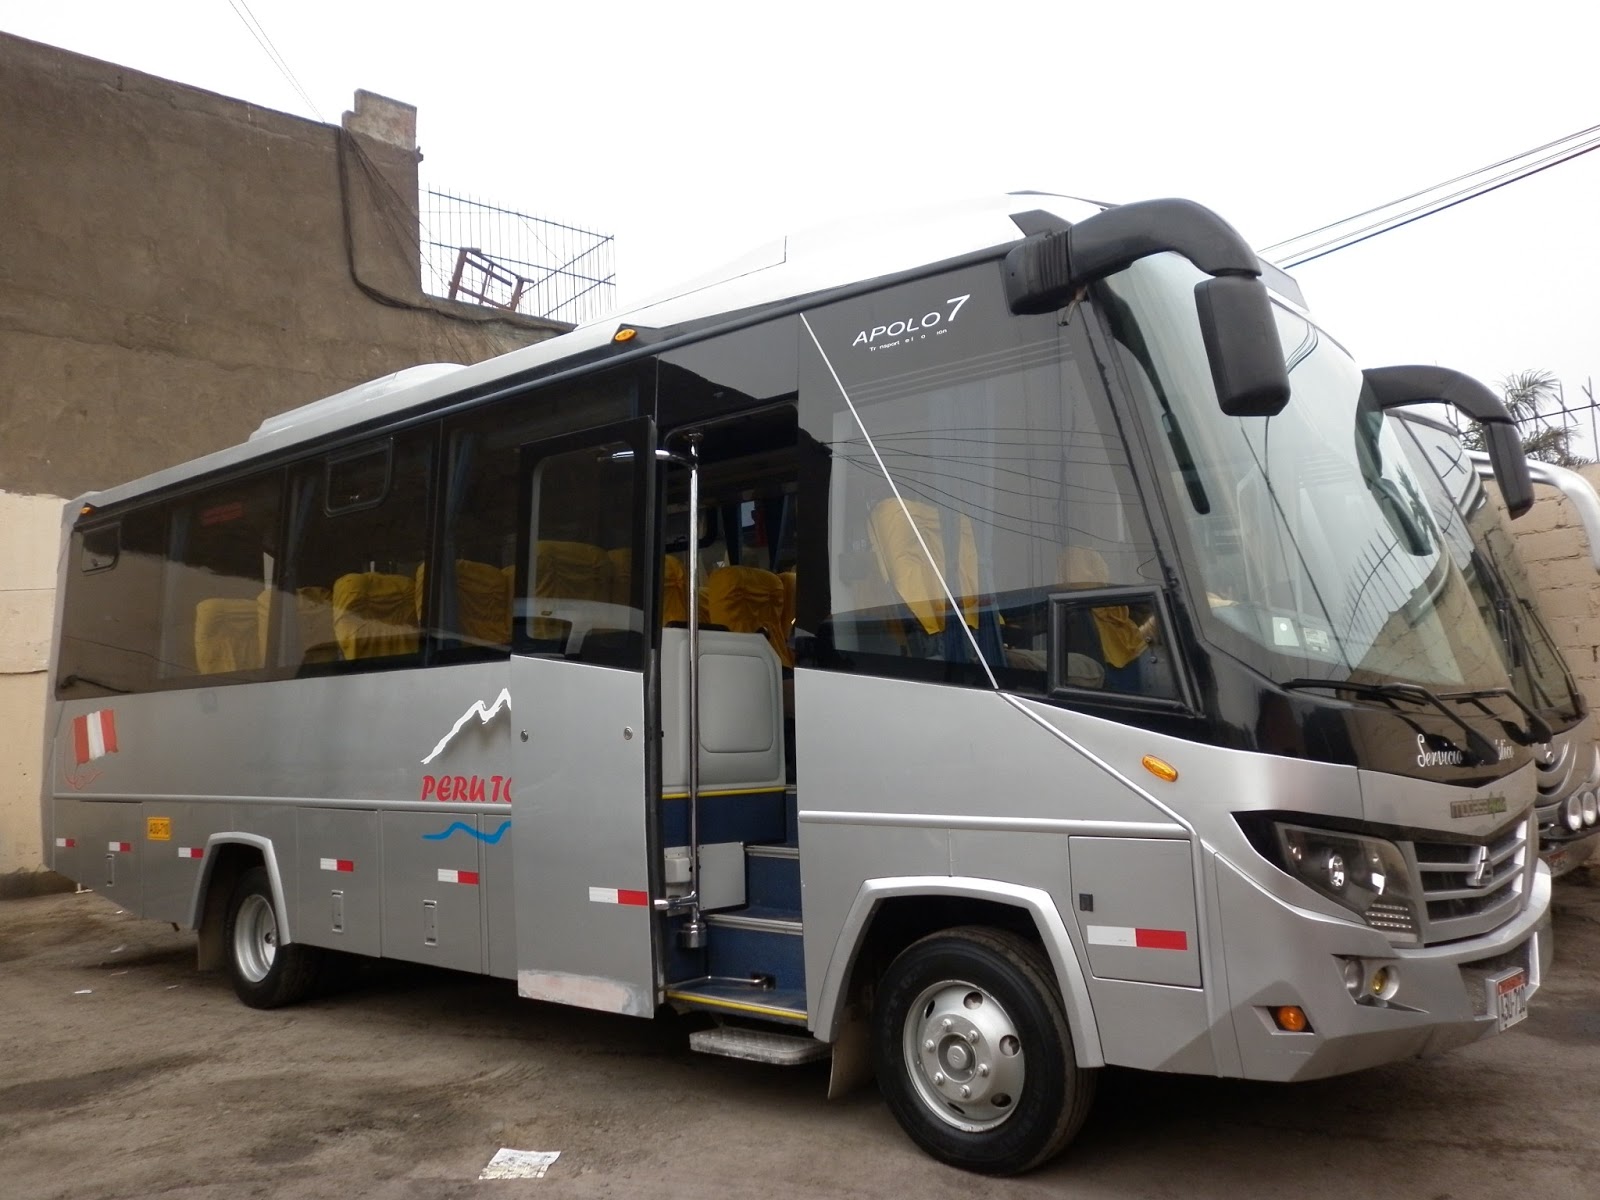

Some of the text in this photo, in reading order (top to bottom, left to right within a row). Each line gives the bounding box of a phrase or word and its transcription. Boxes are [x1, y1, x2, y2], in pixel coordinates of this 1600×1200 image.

[852, 293, 971, 347] APOLO 7
[1417, 733, 1463, 768] Servicio
[421, 774, 486, 802] PERU
